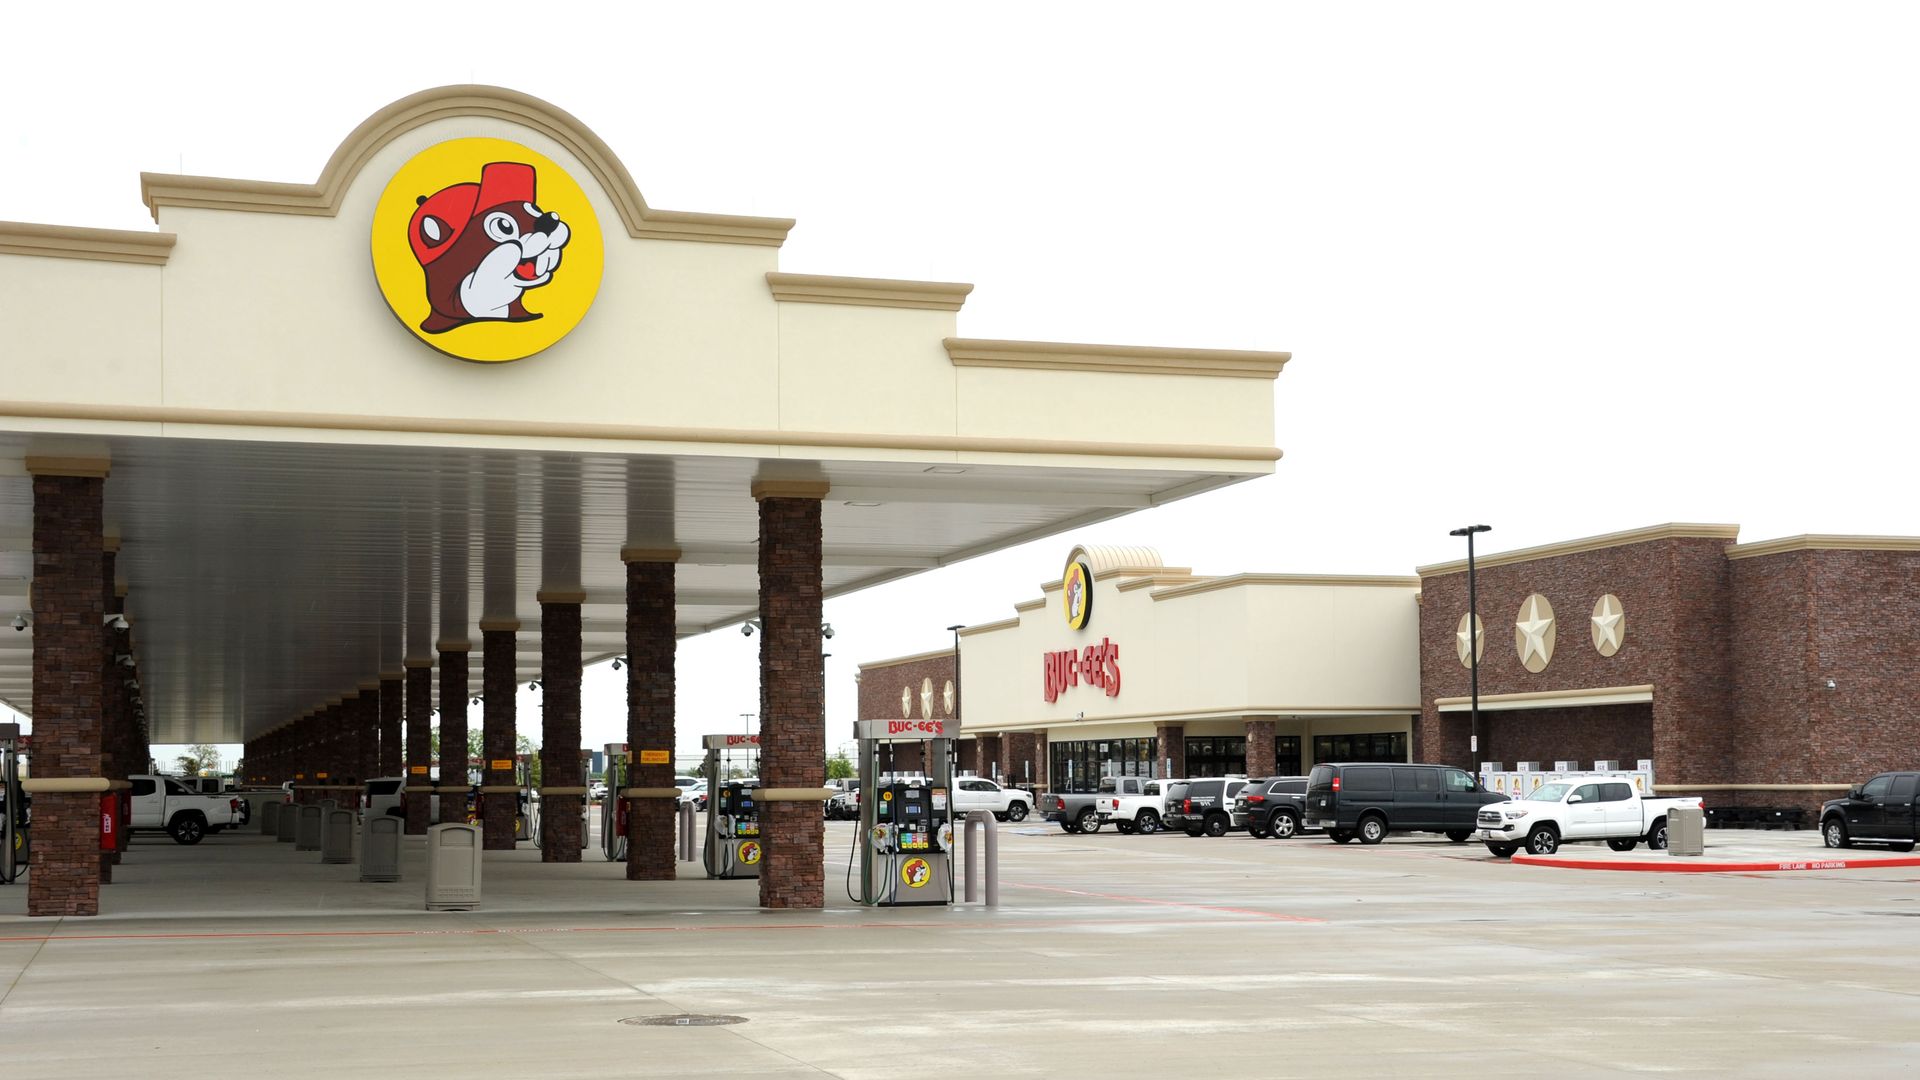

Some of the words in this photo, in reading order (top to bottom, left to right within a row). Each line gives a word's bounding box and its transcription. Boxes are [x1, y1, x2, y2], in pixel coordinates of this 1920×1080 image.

[1044, 637, 1120, 703] BUC-EE'S
[888, 720, 945, 735] BUC-EE'S
[726, 735, 761, 746] BUC-EE
[1821, 861, 1846, 869] PARKING
